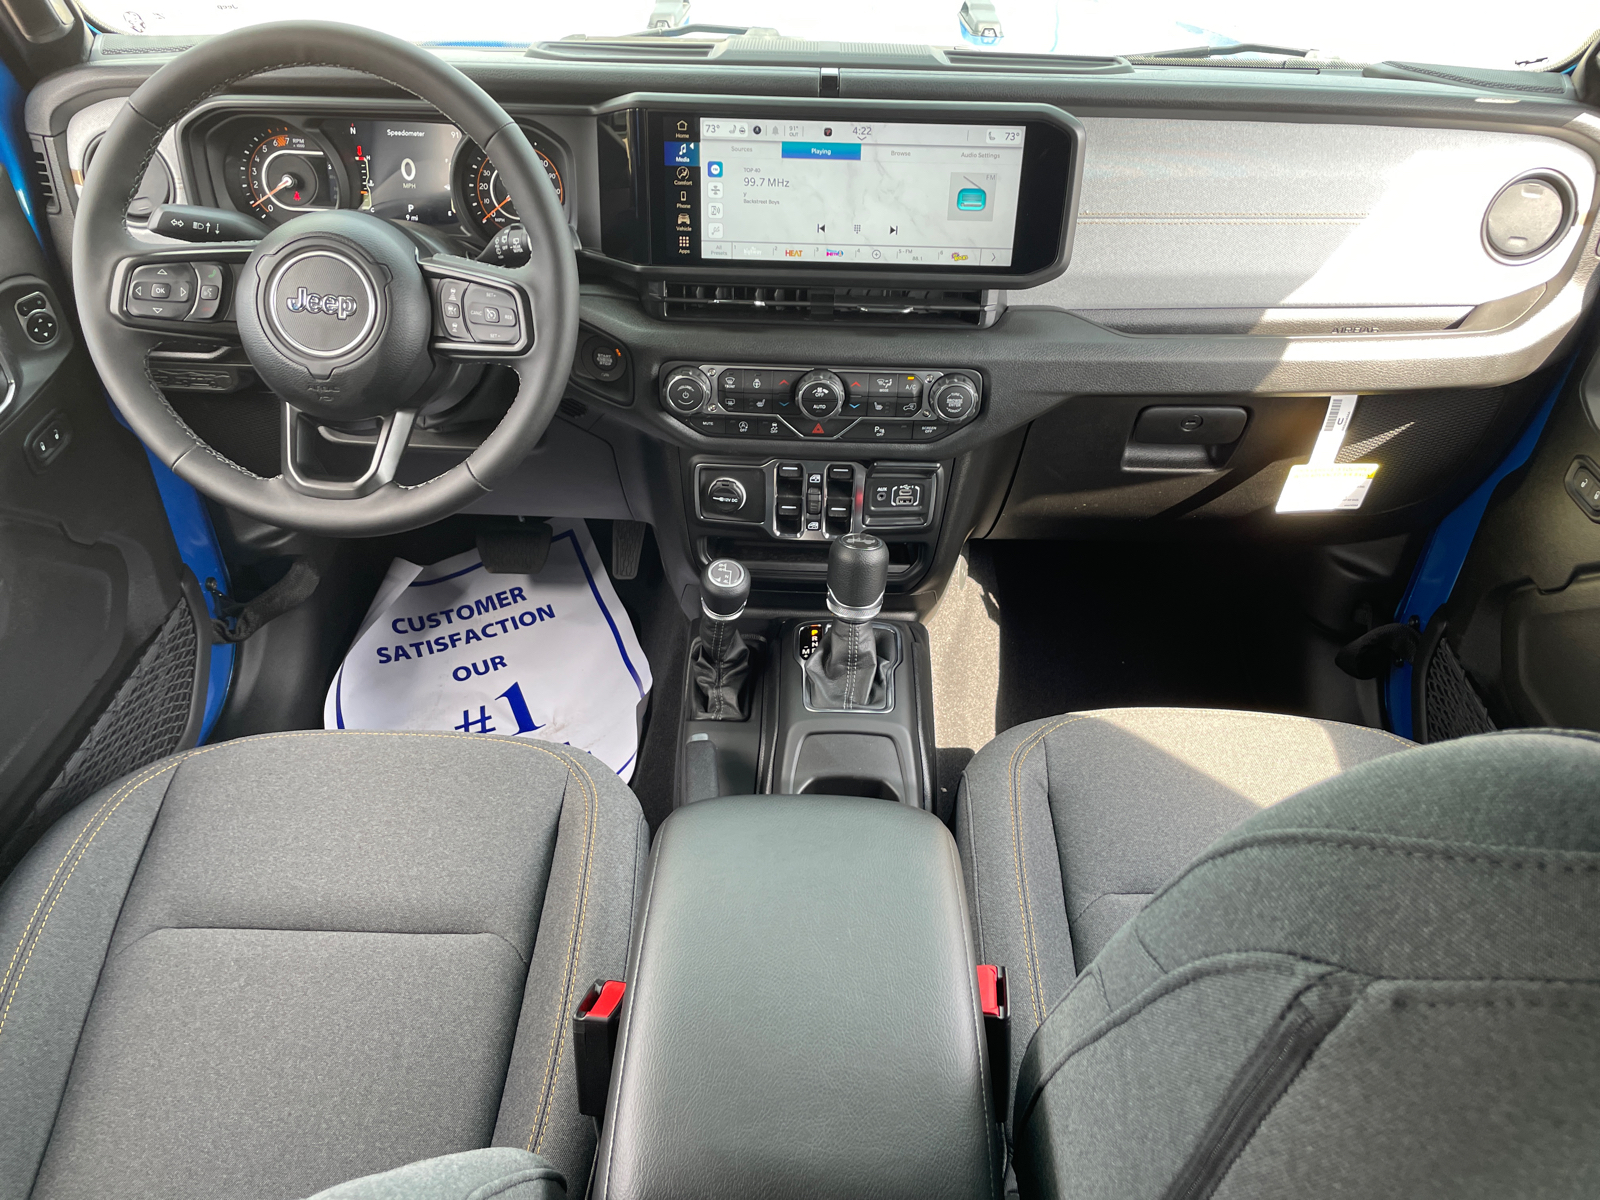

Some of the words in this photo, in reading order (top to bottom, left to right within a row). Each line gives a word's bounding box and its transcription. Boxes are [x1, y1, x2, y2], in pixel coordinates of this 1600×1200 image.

[387, 129, 425, 138] Speedometer
[852, 127, 872, 136] 4:22
[401, 158, 416, 181] 0
[744, 178, 765, 187] 99.7
[767, 178, 790, 187] MHz
[287, 287, 357, 320] Jeep
[391, 586, 527, 634] CUSTOMER
[376, 604, 555, 664] SATISFACTION
[452, 655, 508, 682] OUR
[454, 682, 546, 737] #1
